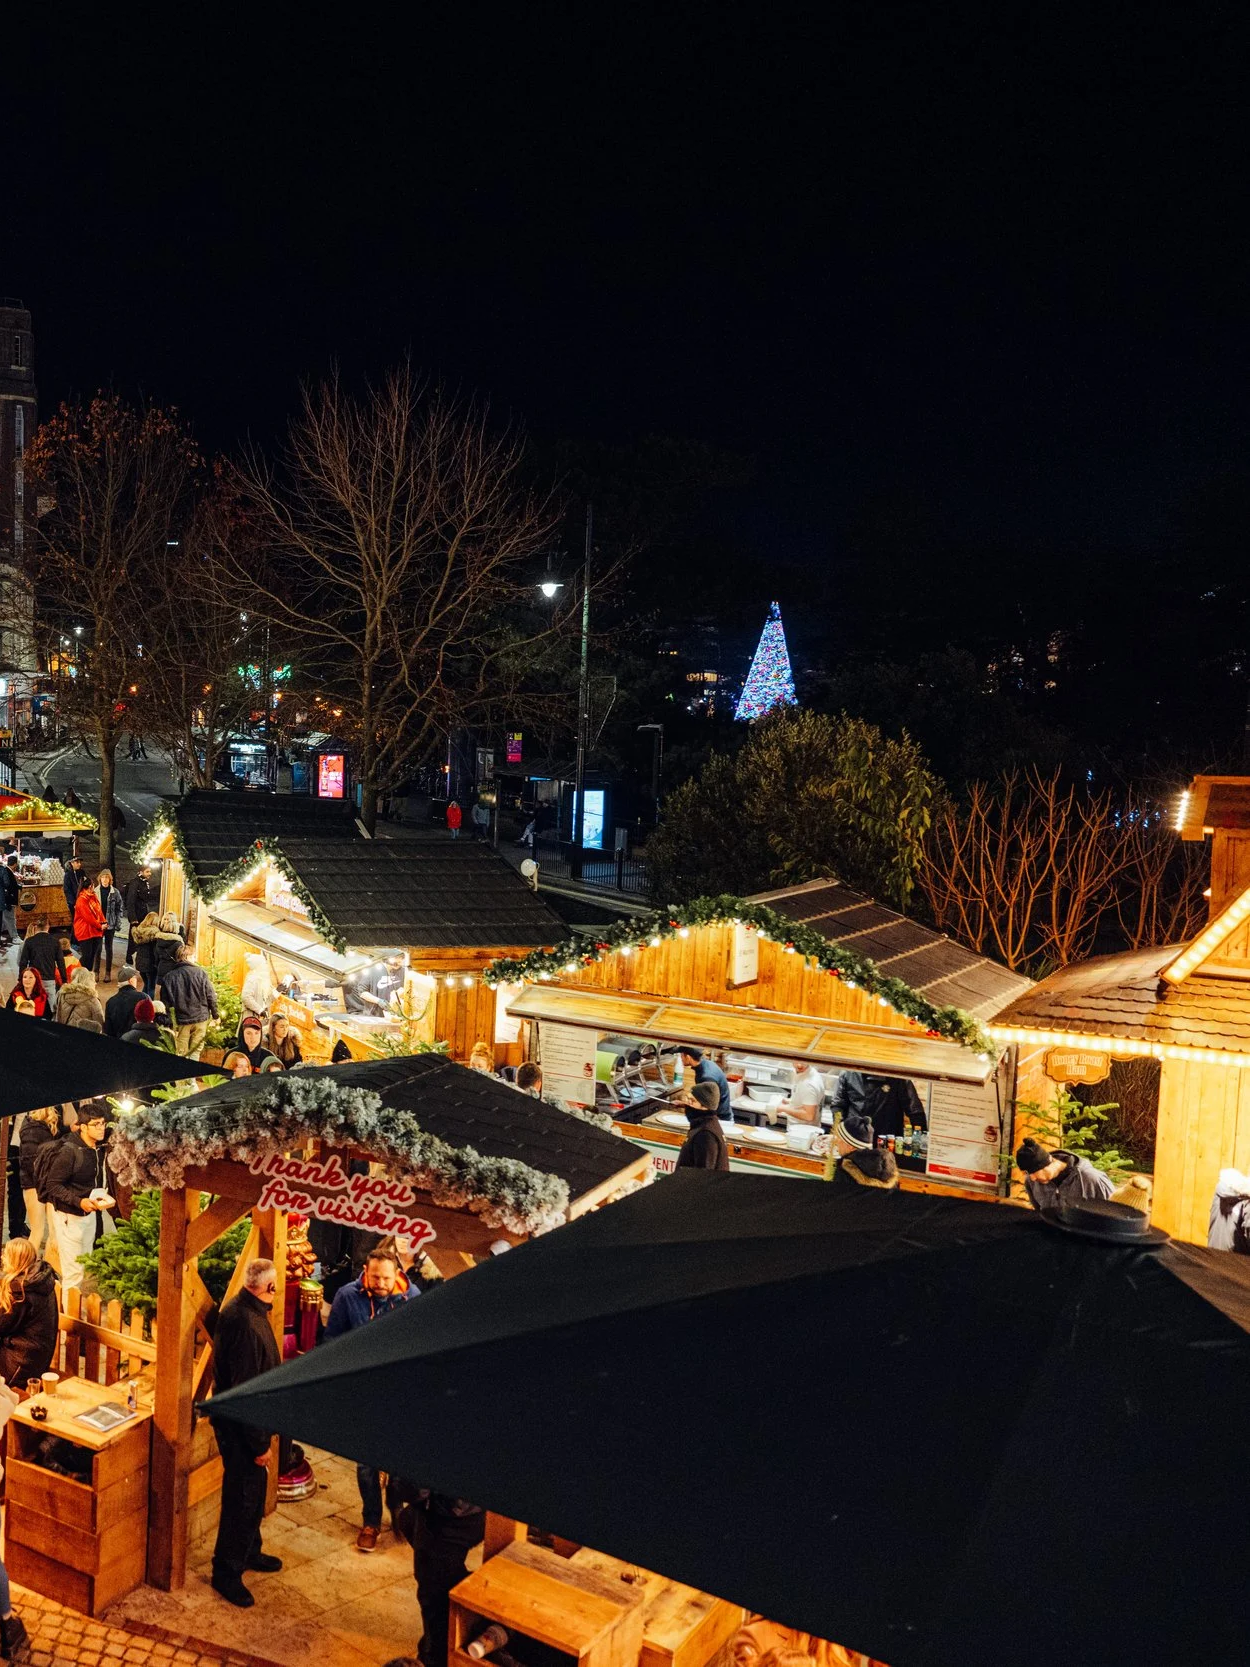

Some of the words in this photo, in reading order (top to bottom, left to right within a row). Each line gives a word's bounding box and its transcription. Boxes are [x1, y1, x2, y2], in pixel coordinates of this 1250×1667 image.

[351, 1176, 412, 1202] you
[261, 1181, 311, 1207] for
[318, 1199, 432, 1248] visiting
